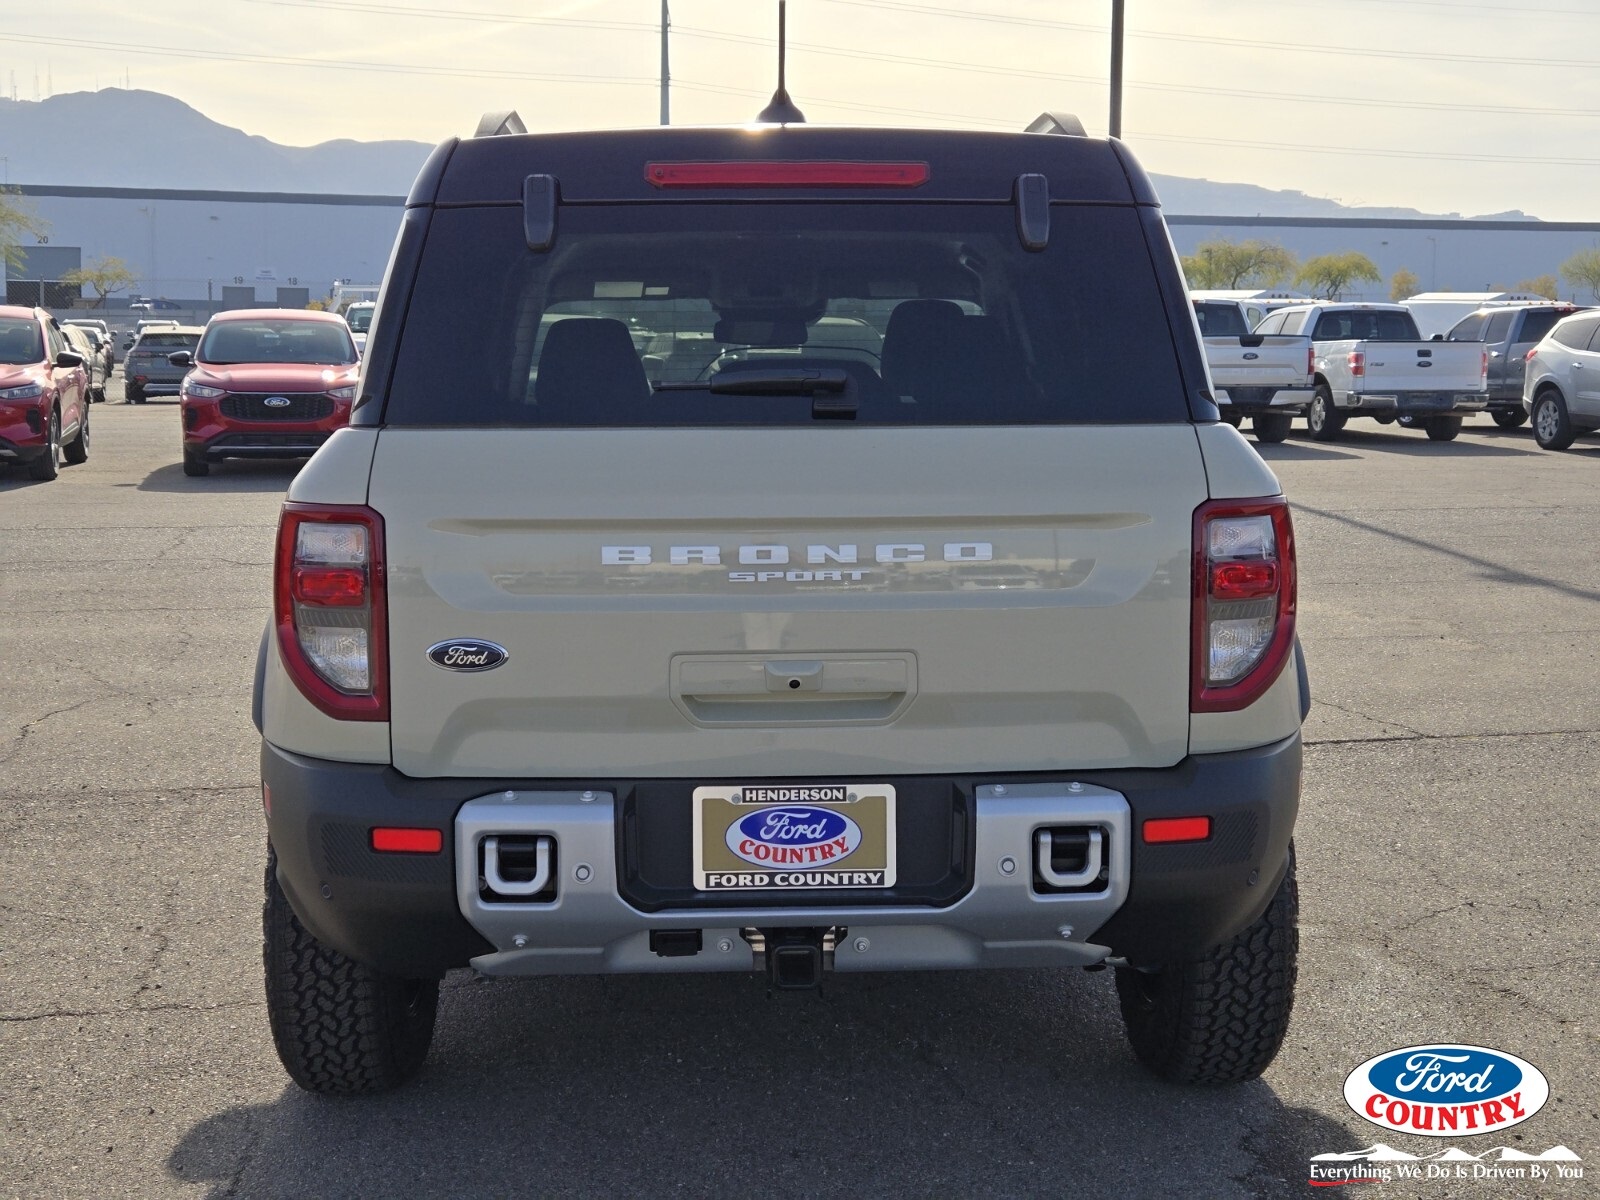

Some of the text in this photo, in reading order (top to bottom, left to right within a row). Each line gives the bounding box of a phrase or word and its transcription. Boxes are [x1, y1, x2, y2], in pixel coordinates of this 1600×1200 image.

[37, 235, 49, 244] 20
[233, 276, 244, 285] 19
[287, 277, 298, 286] 18
[601, 542, 993, 565] BRONCO
[728, 570, 870, 582] SPORT
[444, 646, 488, 665] Ford
[745, 788, 844, 802] HENDERSON
[760, 811, 828, 840] Ford
[739, 836, 850, 864] COUNTRY
[709, 872, 882, 887] FORD COUNTRY
